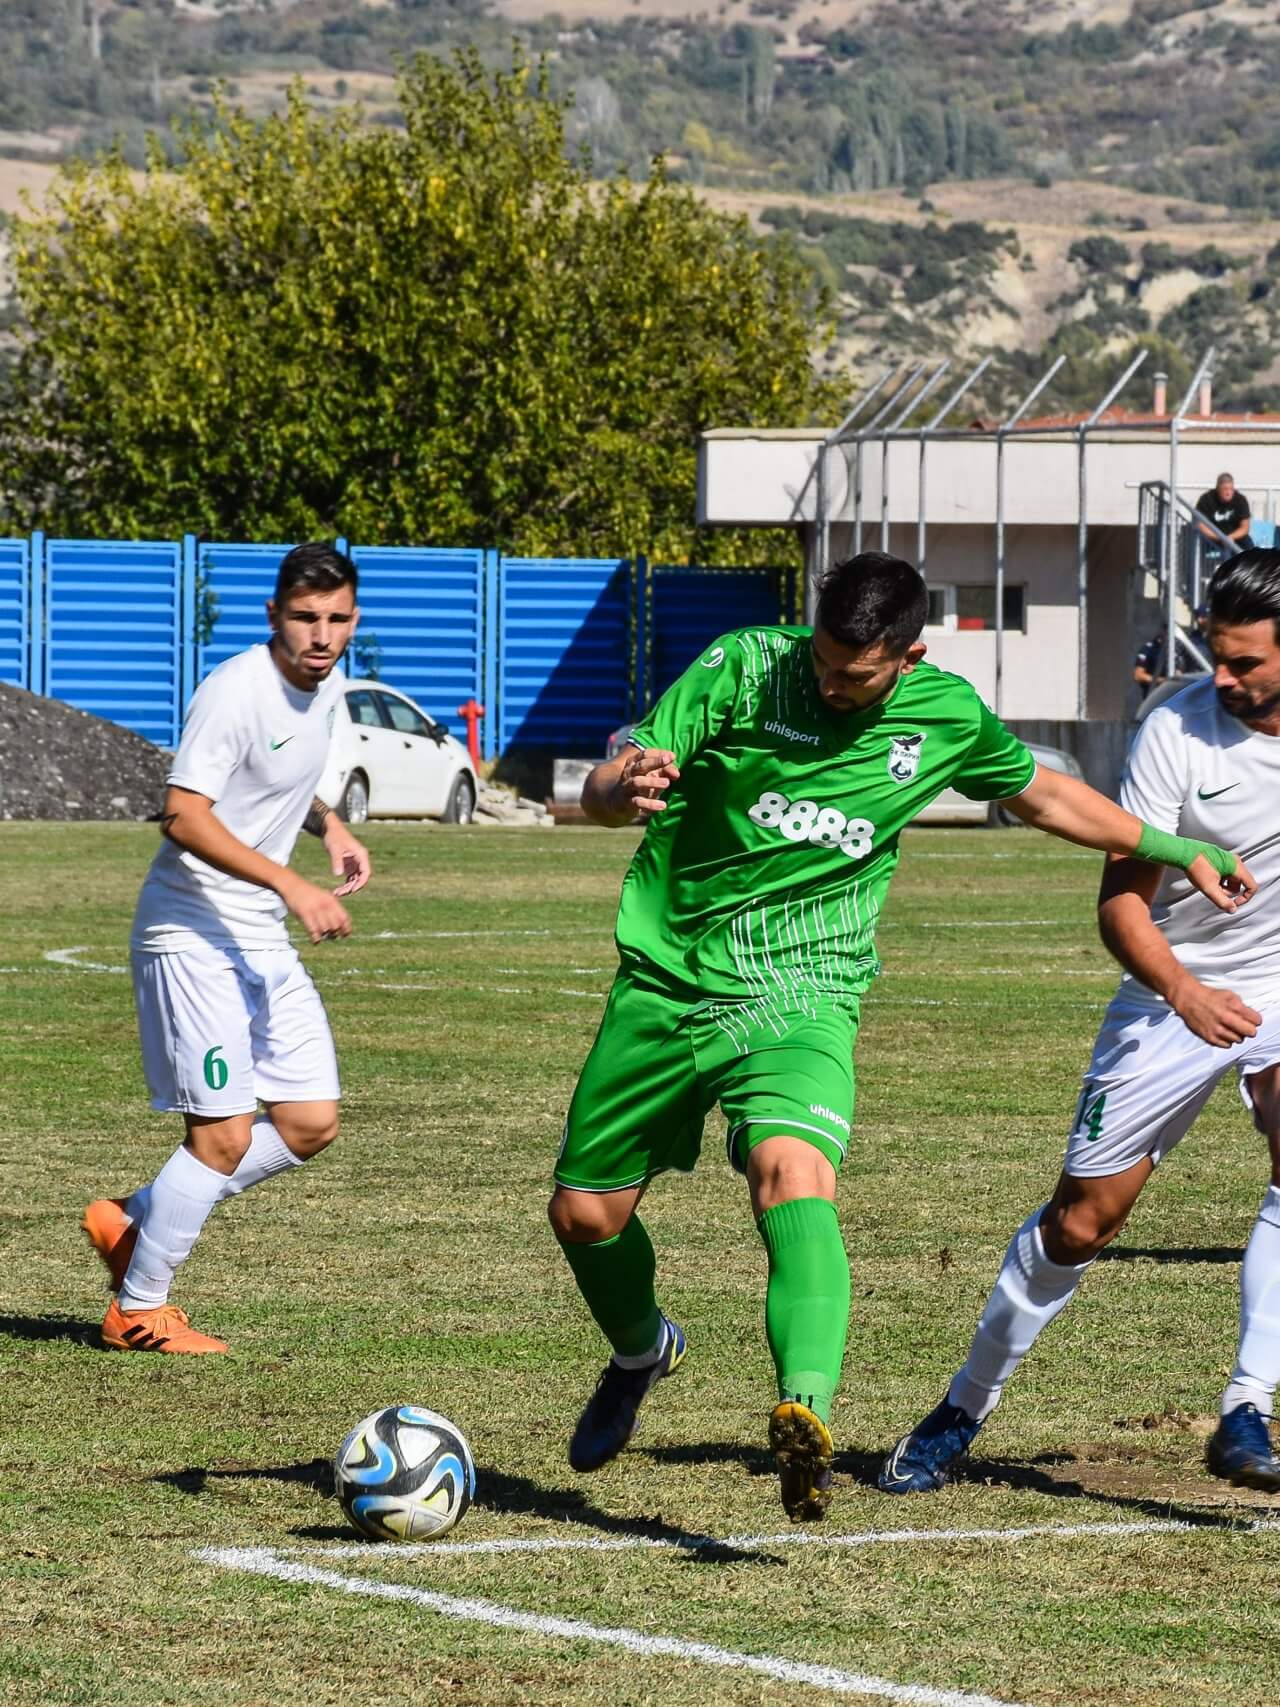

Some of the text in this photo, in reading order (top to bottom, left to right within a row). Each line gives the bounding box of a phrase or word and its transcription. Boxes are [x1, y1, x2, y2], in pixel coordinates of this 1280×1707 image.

[764, 720, 820, 746] uhlsport
[748, 791, 875, 859] 8888
[203, 1045, 229, 1091] 6
